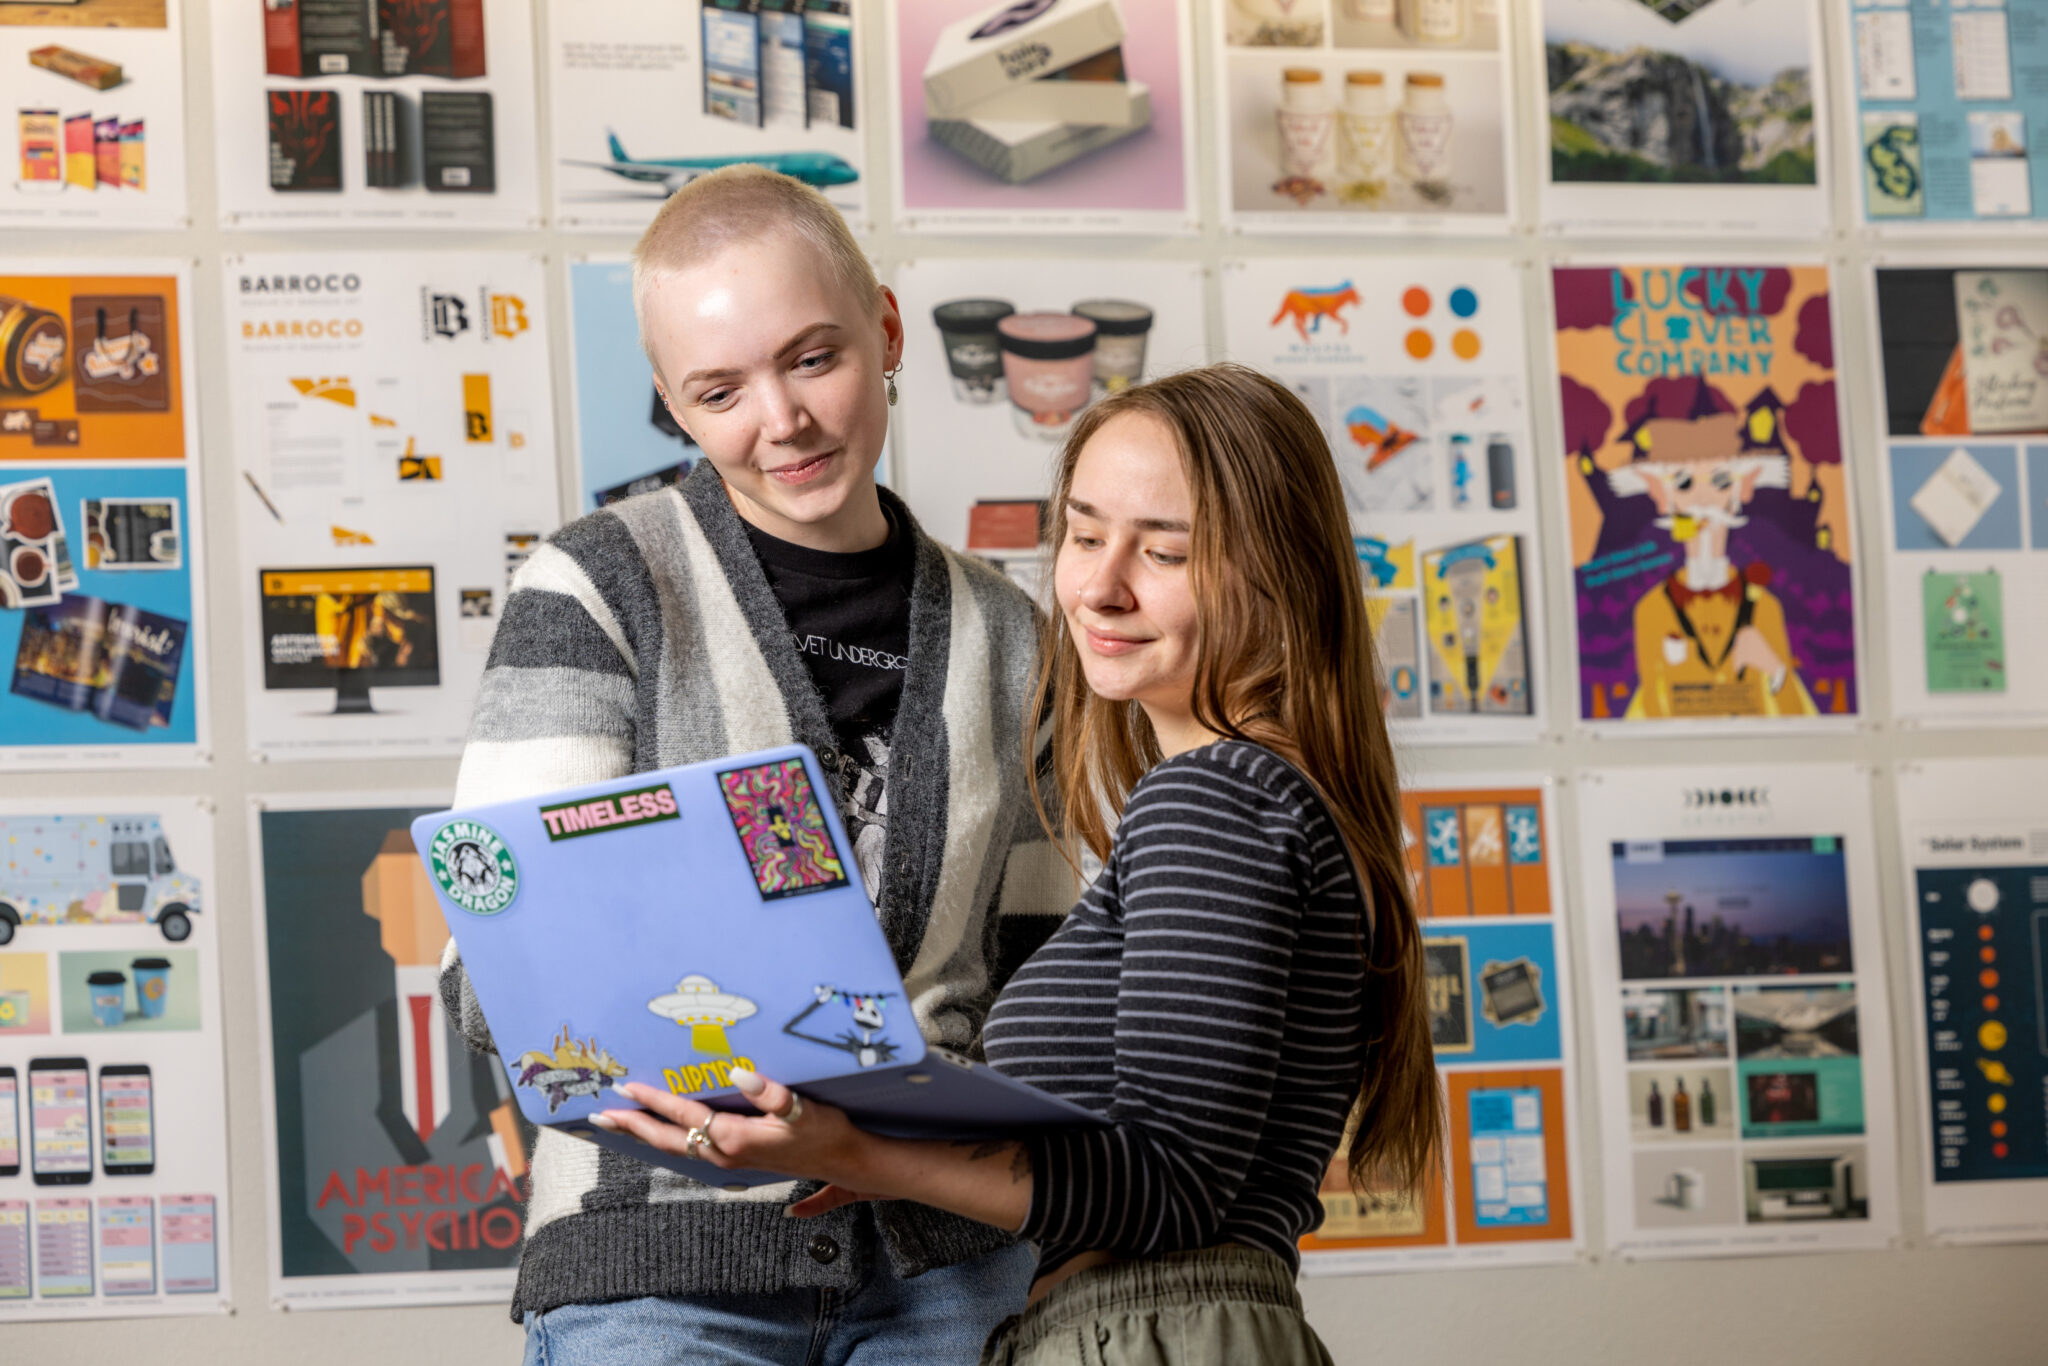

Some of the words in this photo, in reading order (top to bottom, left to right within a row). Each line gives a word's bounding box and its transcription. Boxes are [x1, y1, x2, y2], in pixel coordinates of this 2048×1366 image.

[240, 274, 361, 293] BARROCO
[1612, 268, 1765, 310] LUCKY
[241, 319, 363, 338] BARROCO
[1613, 311, 1773, 345] CLVER
[1616, 349, 1774, 375] COMPANY
[541, 789, 678, 835] TIMELESS
[432, 822, 504, 865] JASMINE
[448, 876, 515, 911] DRAGON
[343, 1207, 521, 1253] PSYCHO
